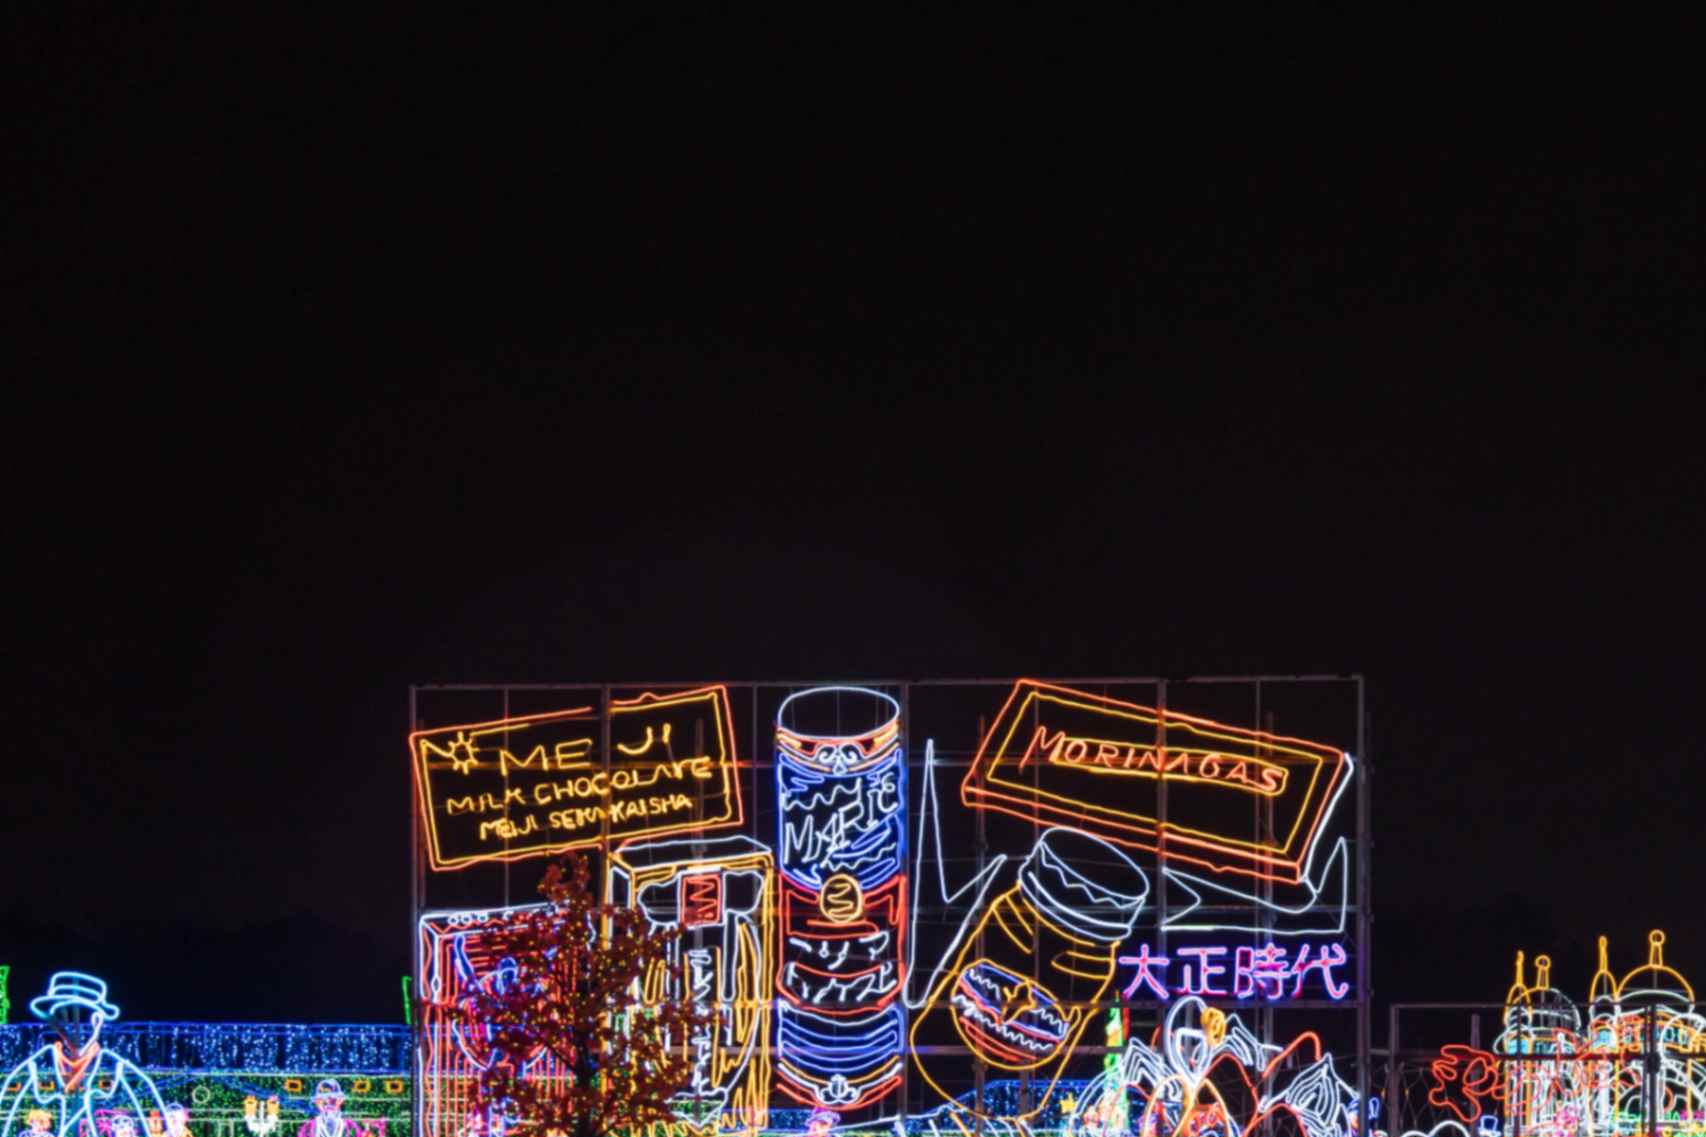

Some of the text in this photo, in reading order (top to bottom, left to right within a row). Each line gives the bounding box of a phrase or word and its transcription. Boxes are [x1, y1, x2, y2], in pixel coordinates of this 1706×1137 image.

[446, 786, 526, 815] MILK
[1117, 942, 1351, 1000] 大正時代
